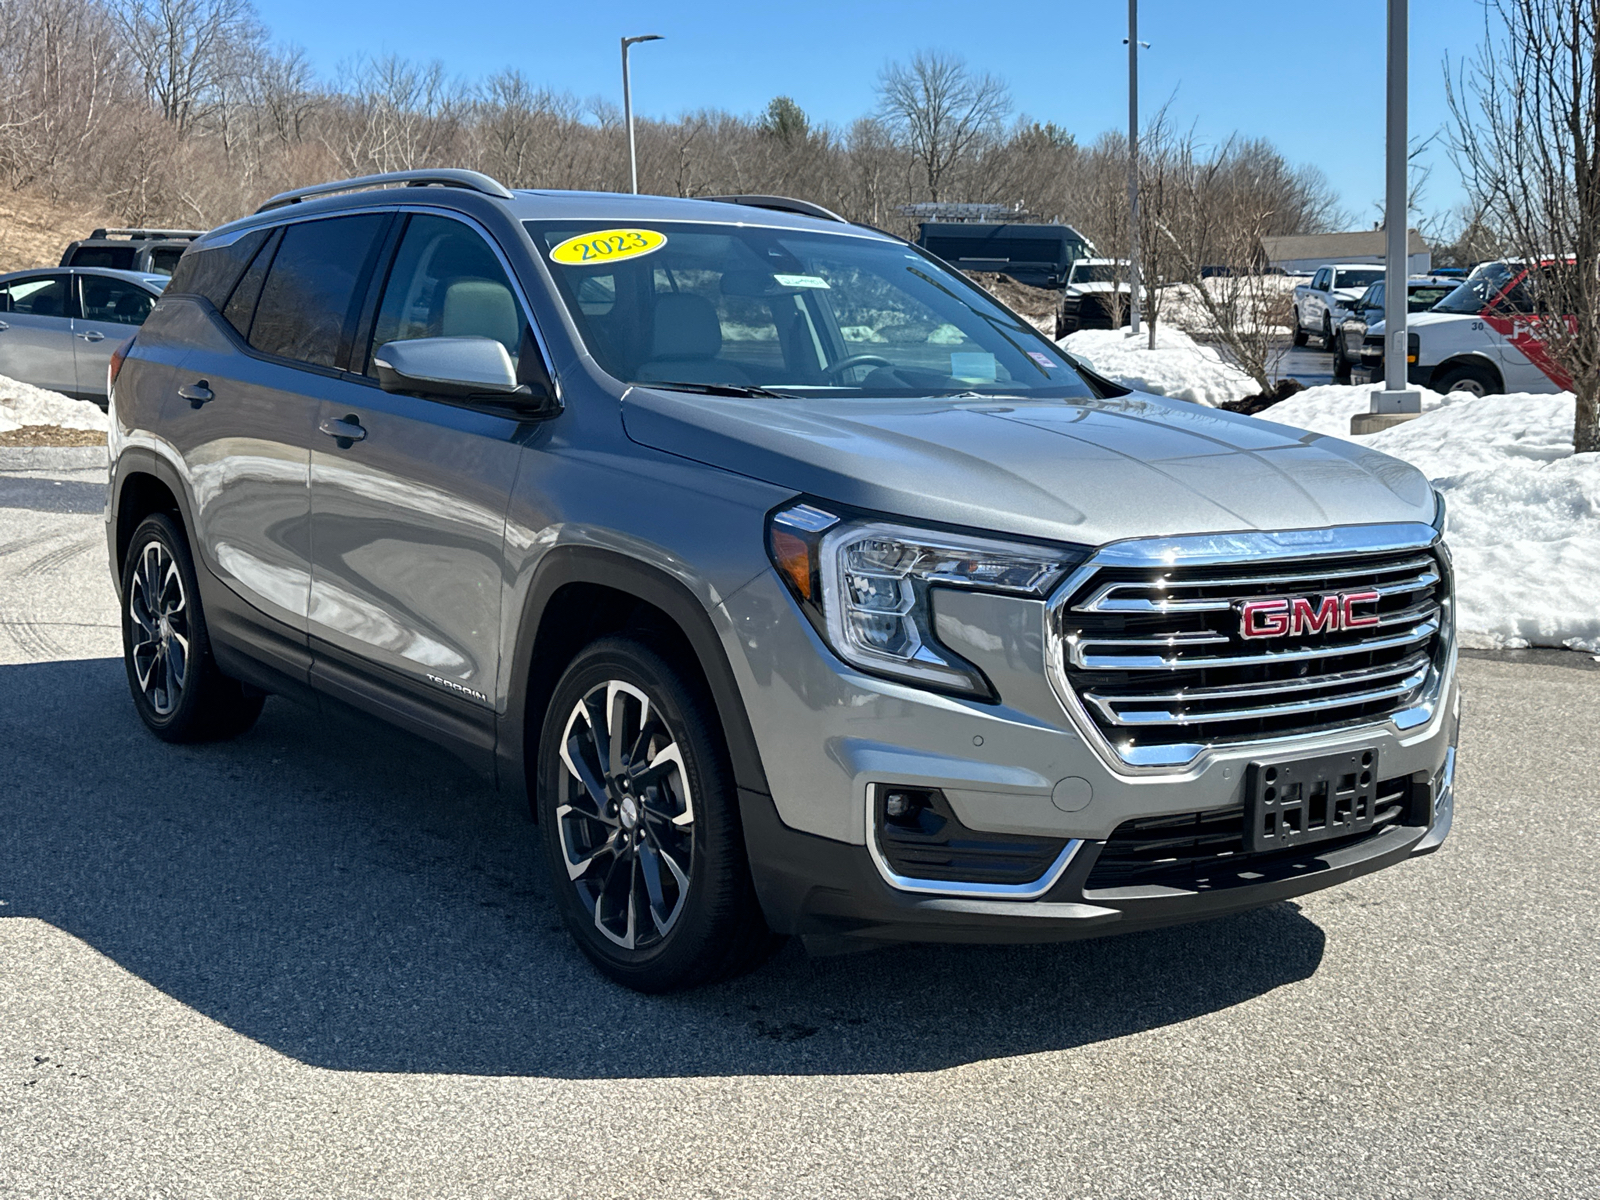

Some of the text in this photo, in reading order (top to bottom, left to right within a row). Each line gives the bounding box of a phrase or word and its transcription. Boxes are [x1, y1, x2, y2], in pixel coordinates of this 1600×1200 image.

[573, 233, 648, 260] 2023
[1471, 322, 1484, 331] 30
[1240, 591, 1380, 640] GMC
[426, 673, 487, 702] TERRAIN
